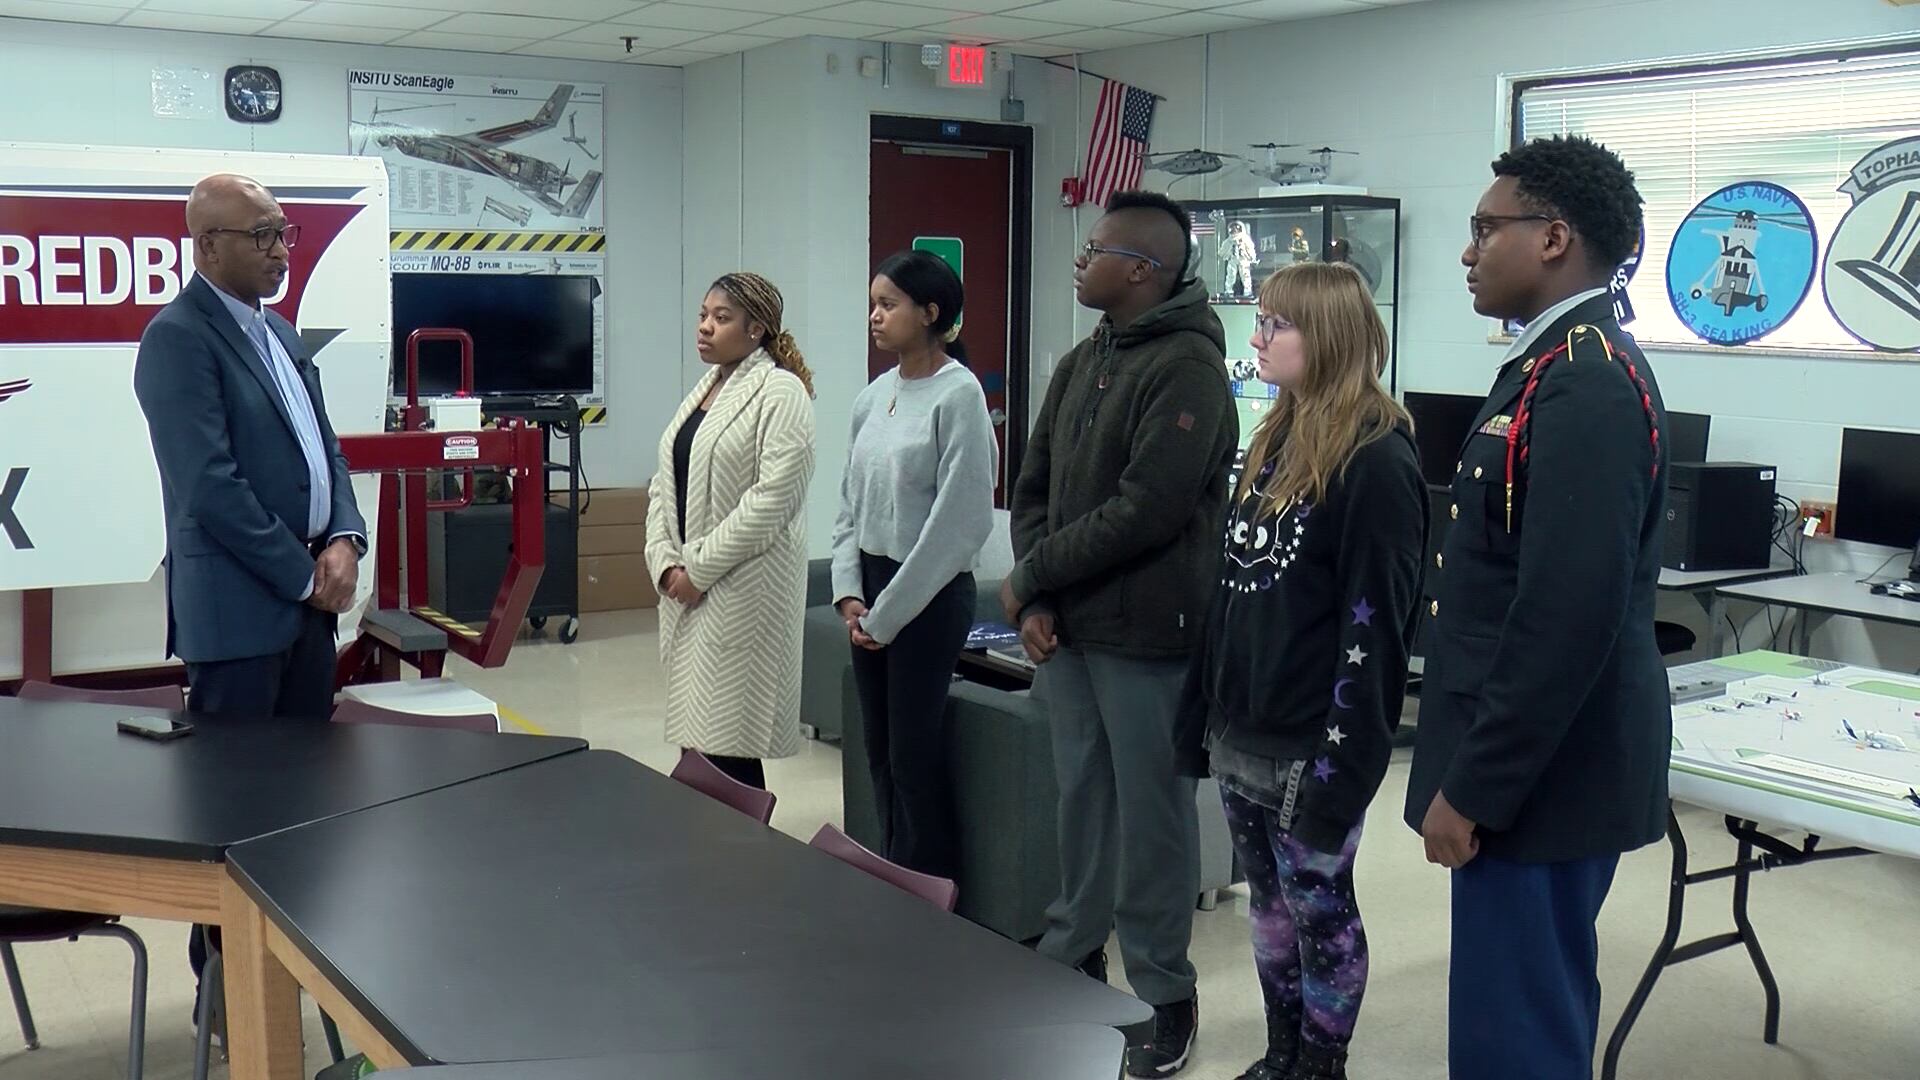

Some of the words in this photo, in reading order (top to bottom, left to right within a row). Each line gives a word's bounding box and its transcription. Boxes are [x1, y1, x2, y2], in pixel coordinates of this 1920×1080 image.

[950, 47, 985, 83] EXIT
[349, 71, 390, 85] INSITU
[393, 74, 455, 92] ScanEagle
[1752, 185, 1792, 208] NAVY
[430, 255, 472, 271] MQ-8B
[1674, 291, 1697, 325] SH-3
[1701, 323, 1728, 341] SEA
[1732, 319, 1772, 340] KING
